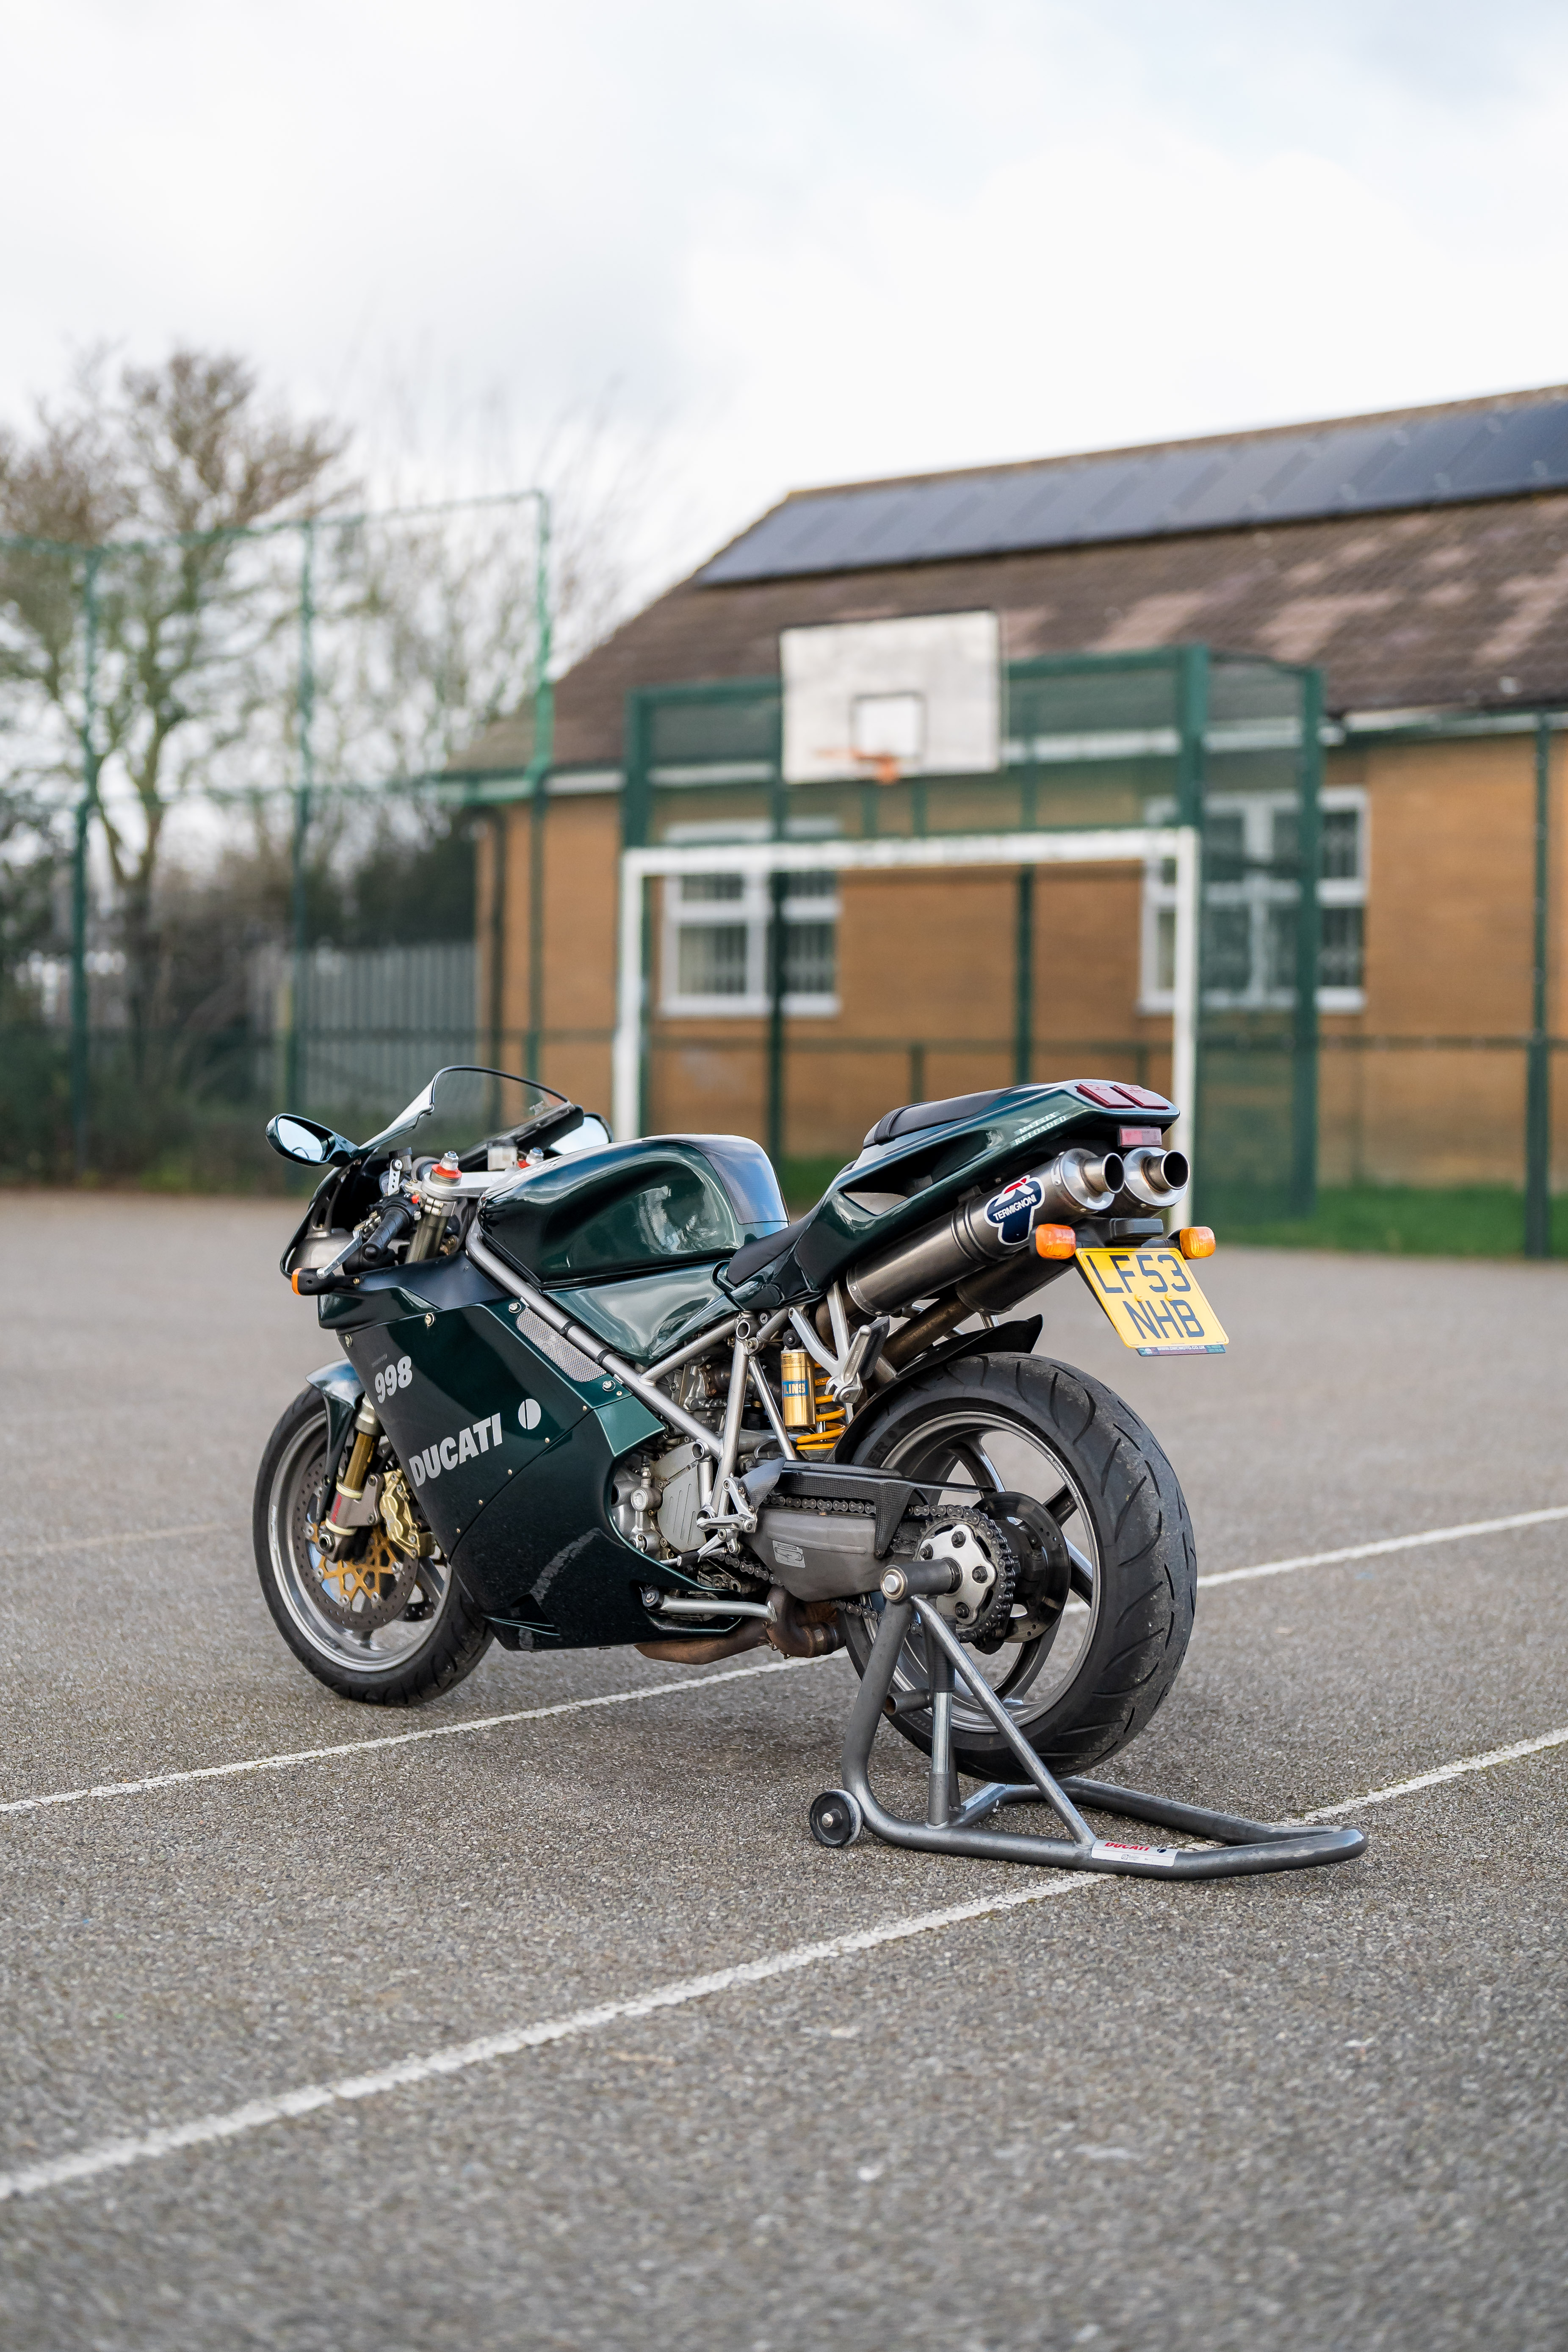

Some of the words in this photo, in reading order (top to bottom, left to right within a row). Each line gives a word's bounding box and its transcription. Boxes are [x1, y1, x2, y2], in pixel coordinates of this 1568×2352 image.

[1015, 1115, 1067, 1145] RELOADED
[1018, 1112, 1056, 1134] MATRIX
[993, 1194, 1037, 1221] TERMIGNONI
[1086, 1254, 1191, 1293] LF53
[1123, 1299, 1205, 1339] NHB
[375, 1356, 412, 1403] 998
[783, 1383, 806, 1395] LINS
[409, 1412, 503, 1487] DUCATI
[1104, 1842, 1150, 1851] DUCATI
